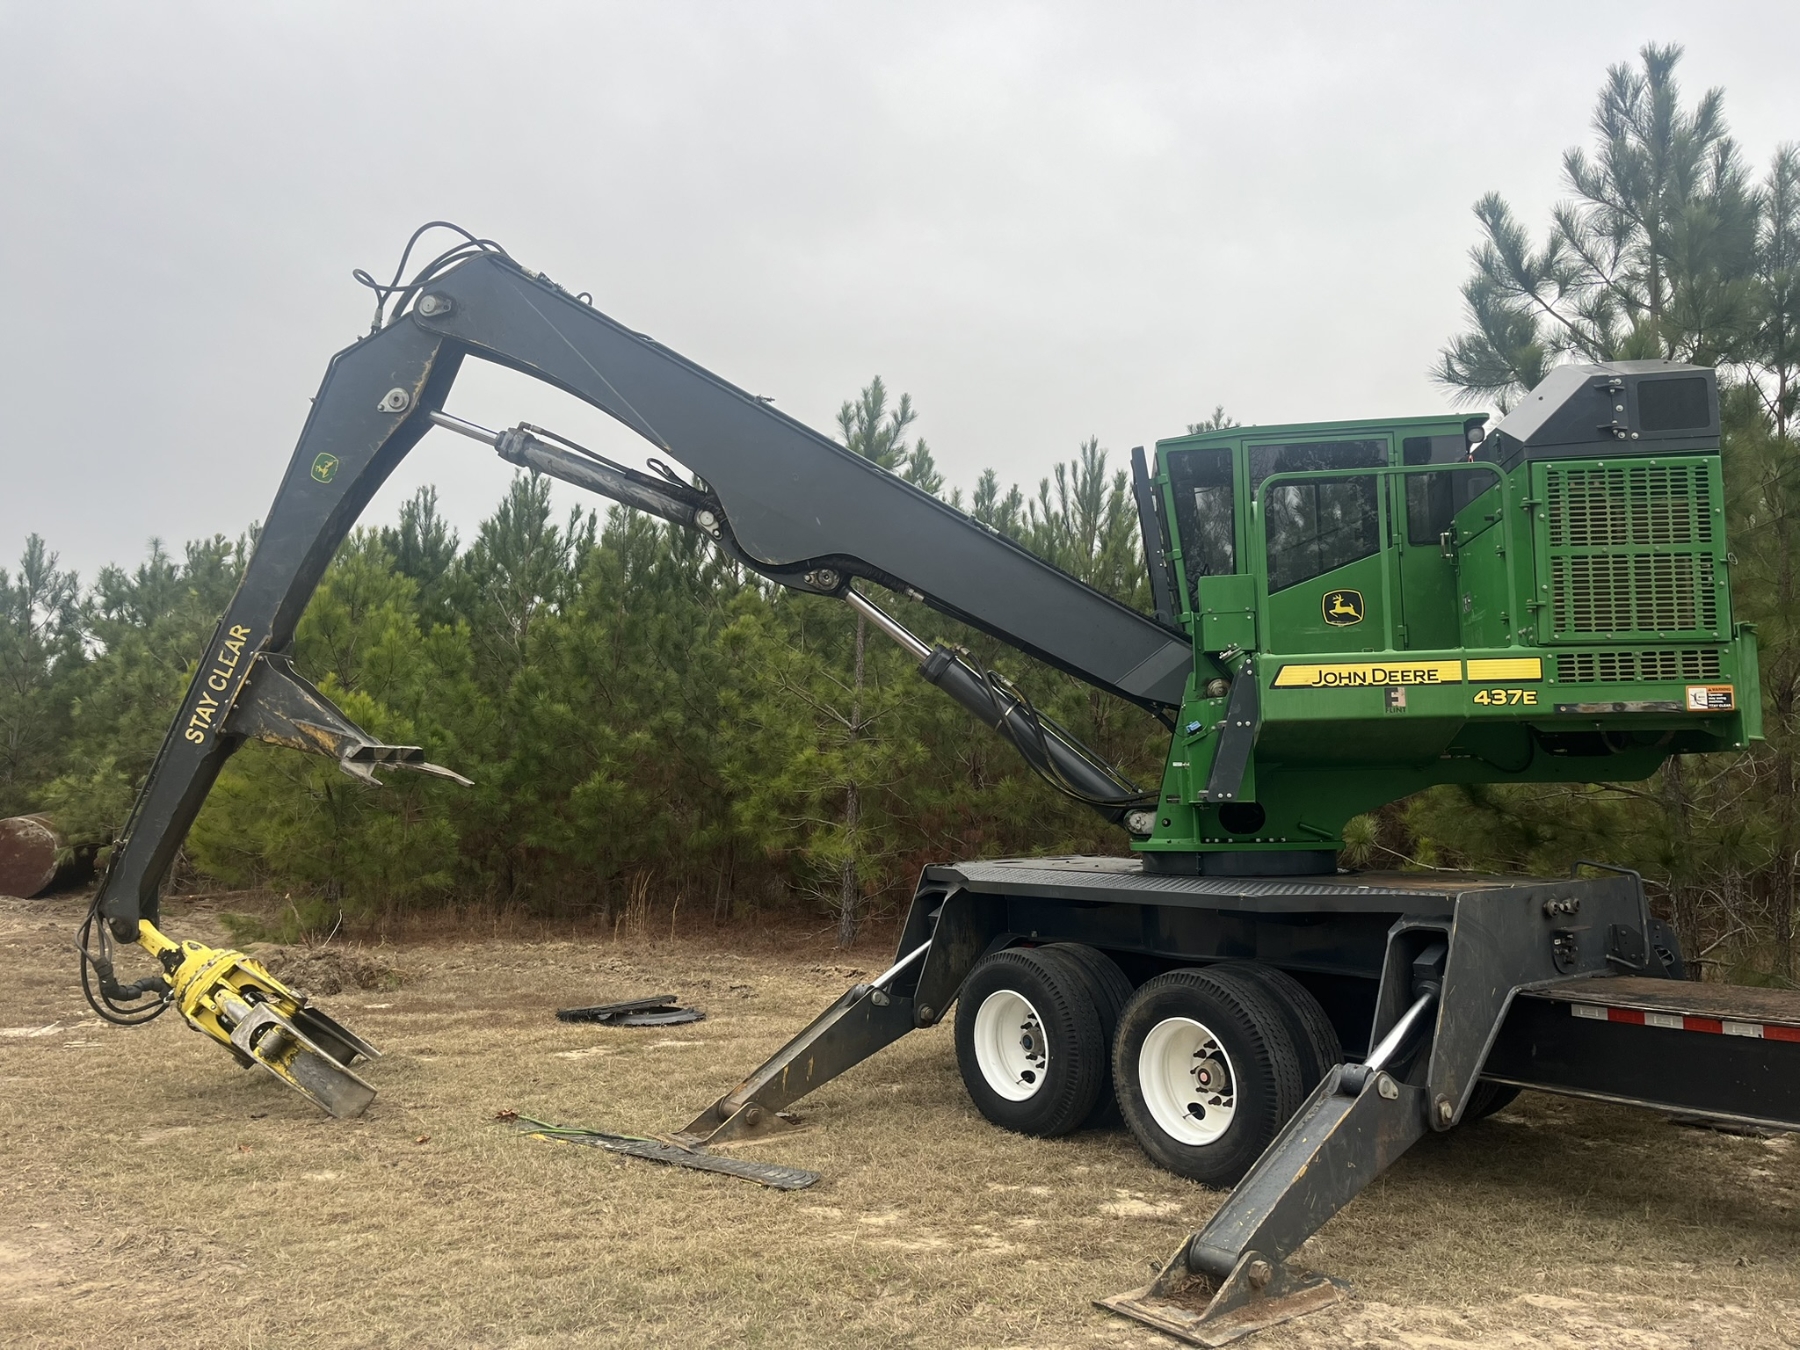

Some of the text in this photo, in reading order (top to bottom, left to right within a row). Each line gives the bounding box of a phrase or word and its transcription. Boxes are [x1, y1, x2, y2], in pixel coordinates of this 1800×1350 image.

[185, 624, 251, 744] STAY CLEAR
[1312, 668, 1439, 685] JOHN DEERE
[1473, 688, 1538, 705] 437E
